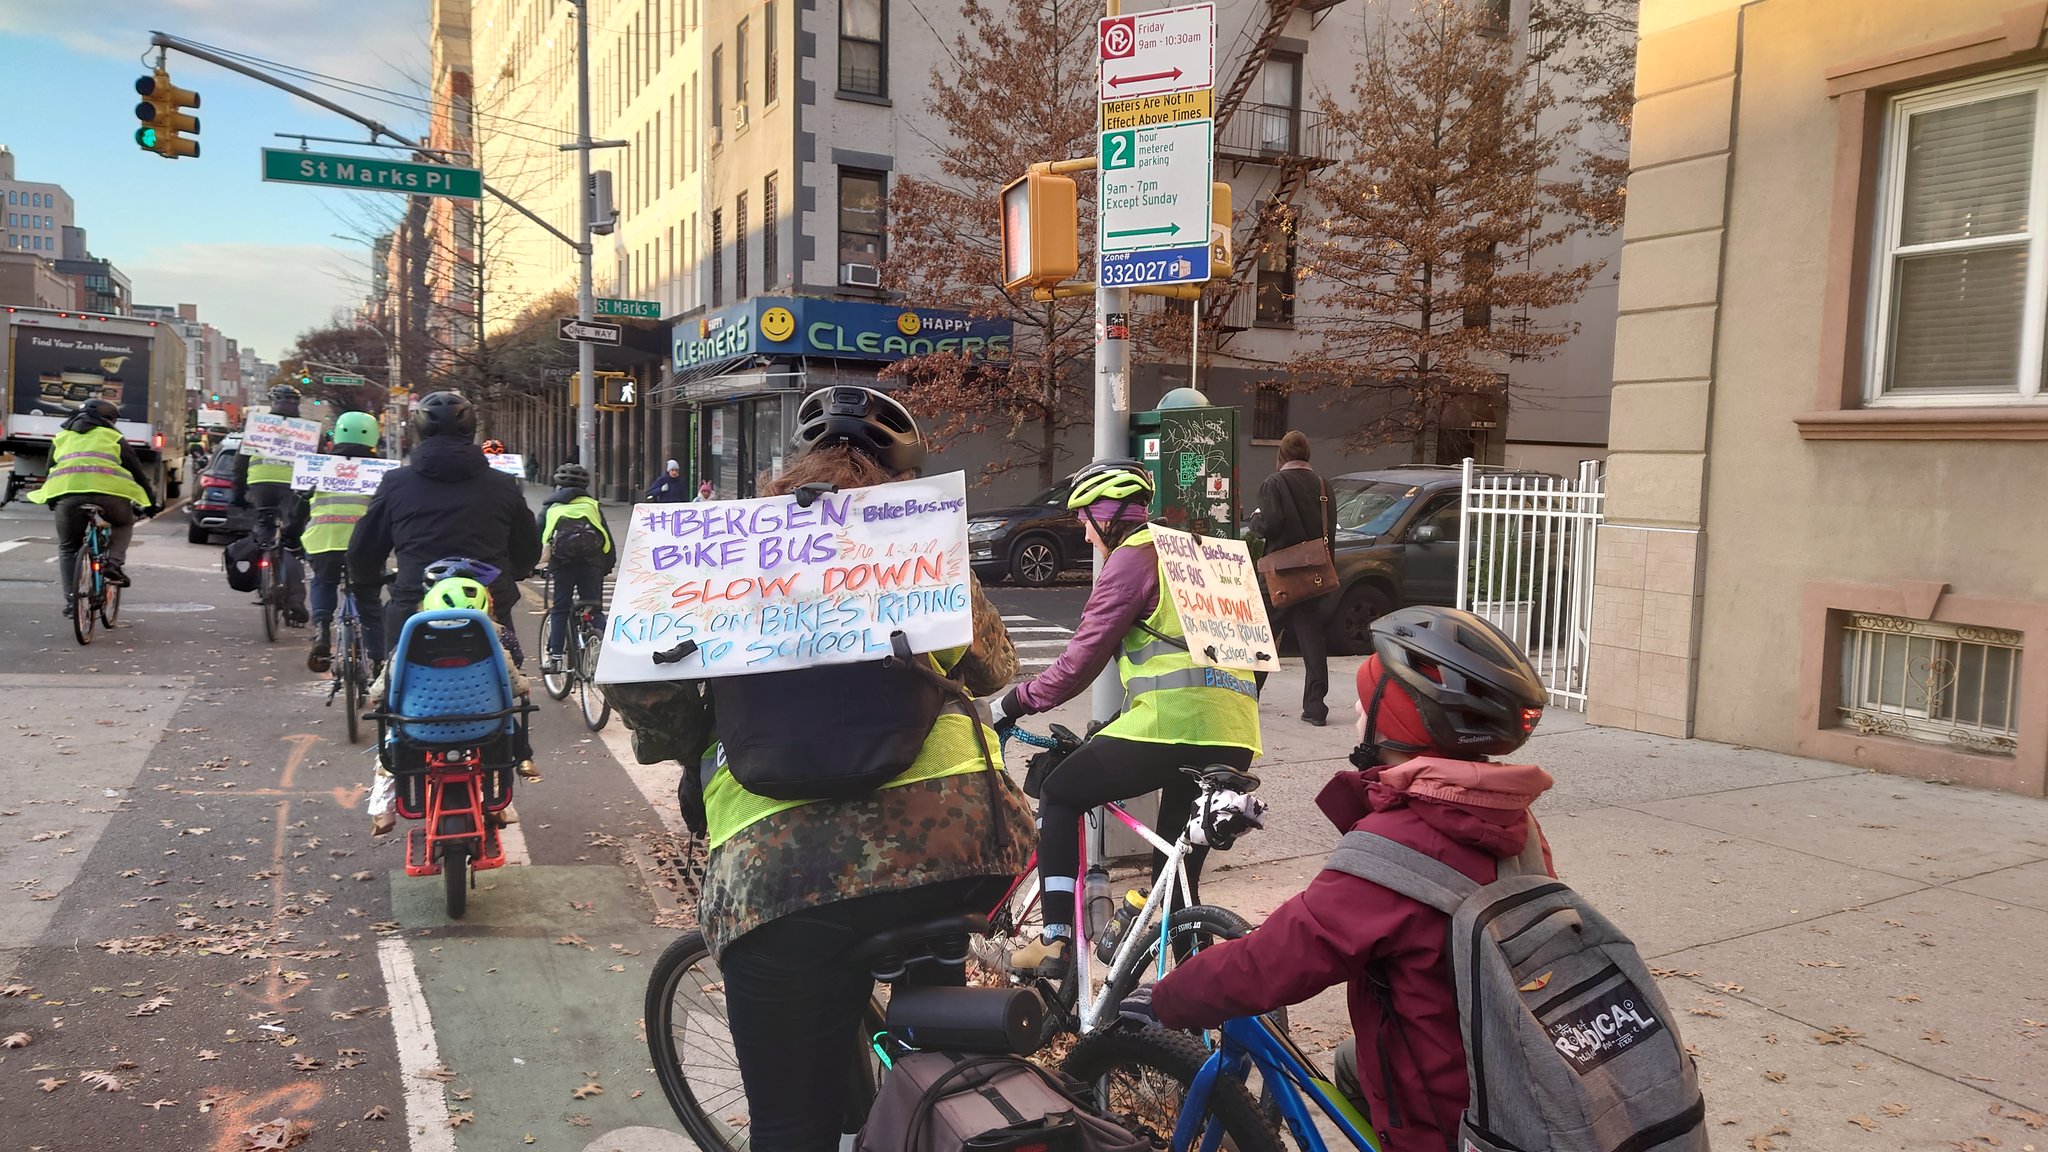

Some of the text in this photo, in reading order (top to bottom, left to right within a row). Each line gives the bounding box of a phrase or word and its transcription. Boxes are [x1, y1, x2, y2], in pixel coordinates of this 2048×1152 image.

[1138, 22, 1165, 35] Friday
[1139, 40, 1157, 50] 9am
[1165, 33, 1201, 46] 10:30am
[1107, 92, 1194, 114] Meters Are Not In
[1107, 108, 1202, 130] Effect Above Times
[1139, 132, 1158, 143] hour
[1139, 142, 1174, 155] metered
[1110, 135, 1127, 167] 2
[1139, 155, 1170, 169] parking
[300, 159, 451, 190] St Marks Pl
[1107, 184, 1127, 195] 9am
[1137, 181, 1158, 194] 7pm
[1106, 192, 1178, 210] Except Sunday
[1104, 252, 1131, 262] Zone#
[1103, 260, 1167, 284] 332027
[597, 299, 659, 315] St Marks Pl
[568, 325, 613, 338] ONE WAY
[922, 318, 972, 332] HAPPY
[32, 336, 134, 354] Find Your Zen Moment.
[674, 315, 748, 367] CLEANERS
[640, 494, 852, 540] #BERGEN
[862, 497, 965, 523] BikeBus.nyc
[758, 532, 837, 570] BUS
[671, 551, 943, 609] SLOW DOWN
[1186, 564, 1206, 588] BUS
[1178, 588, 1254, 624] SLOW DOWN
[710, 612, 752, 633] ON
[697, 627, 887, 668] TO SCHOOL
[1554, 1003, 1655, 1059] RADICAL
